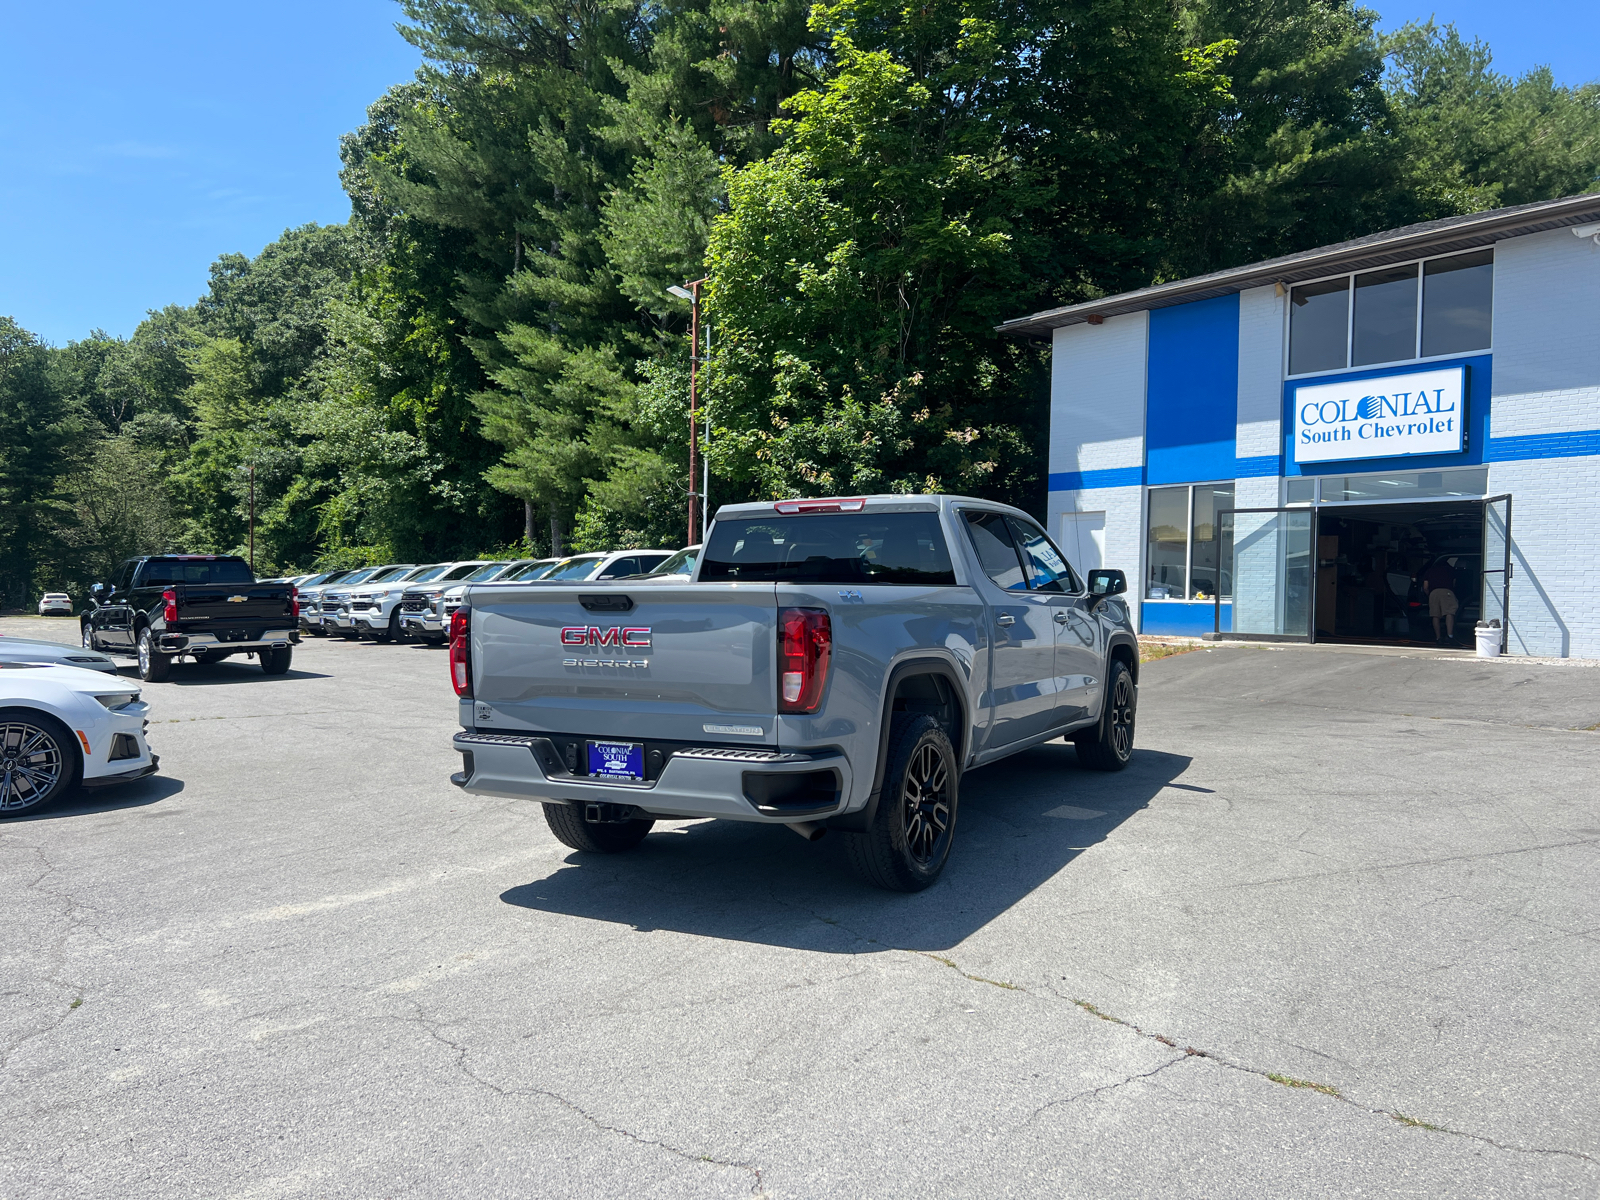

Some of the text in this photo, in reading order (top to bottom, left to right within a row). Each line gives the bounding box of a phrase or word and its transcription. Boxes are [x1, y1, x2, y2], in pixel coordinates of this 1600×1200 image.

[1300, 388, 1455, 426] COLONIAL
[1300, 416, 1455, 445] South Chevrolet
[560, 625, 652, 648] GMC
[562, 658, 649, 669] SIERRA
[706, 725, 760, 734] ELEVATION
[598, 746, 632, 755] COLONIAL
[603, 753, 627, 761] SOUTH
